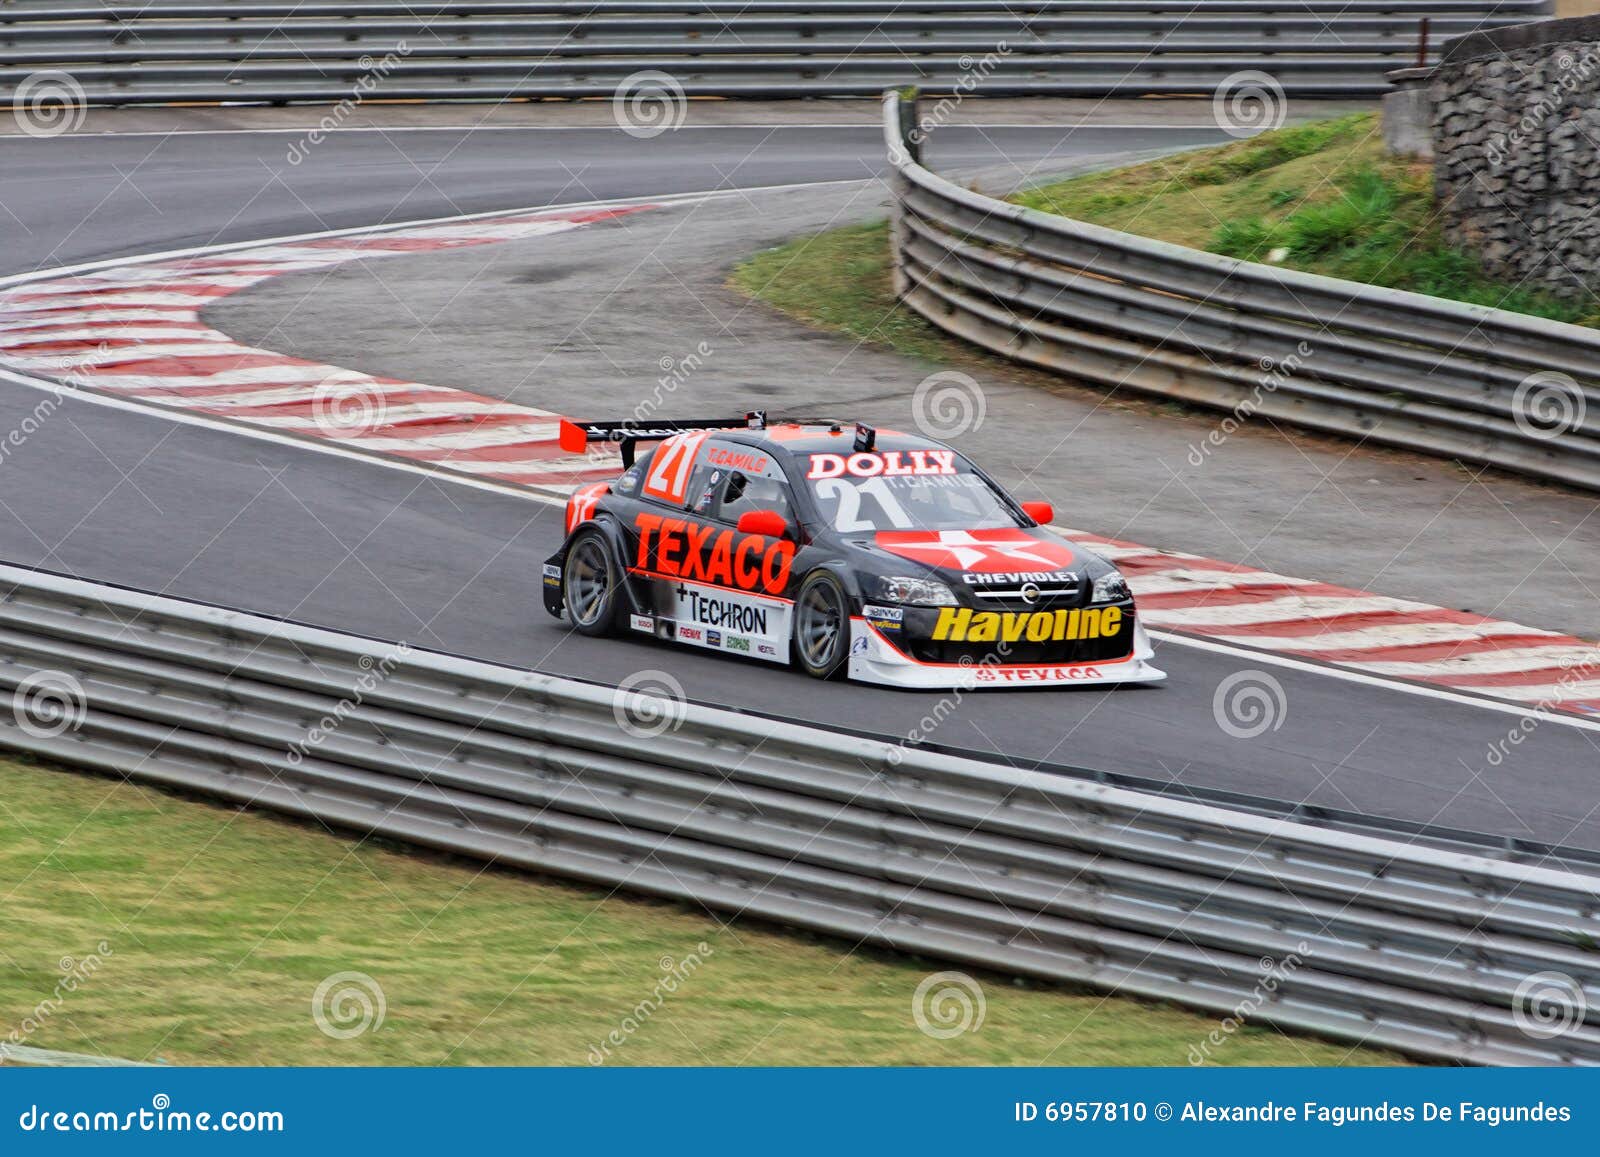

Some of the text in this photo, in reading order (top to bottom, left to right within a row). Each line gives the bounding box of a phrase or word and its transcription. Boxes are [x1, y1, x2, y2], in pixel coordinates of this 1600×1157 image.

[648, 434, 709, 497] 21
[807, 450, 957, 479] DOLLY
[815, 476, 914, 532] 21
[634, 512, 796, 594] TEXACO
[962, 571, 1080, 585] CHEVROLET
[931, 605, 1122, 642] Havoline
